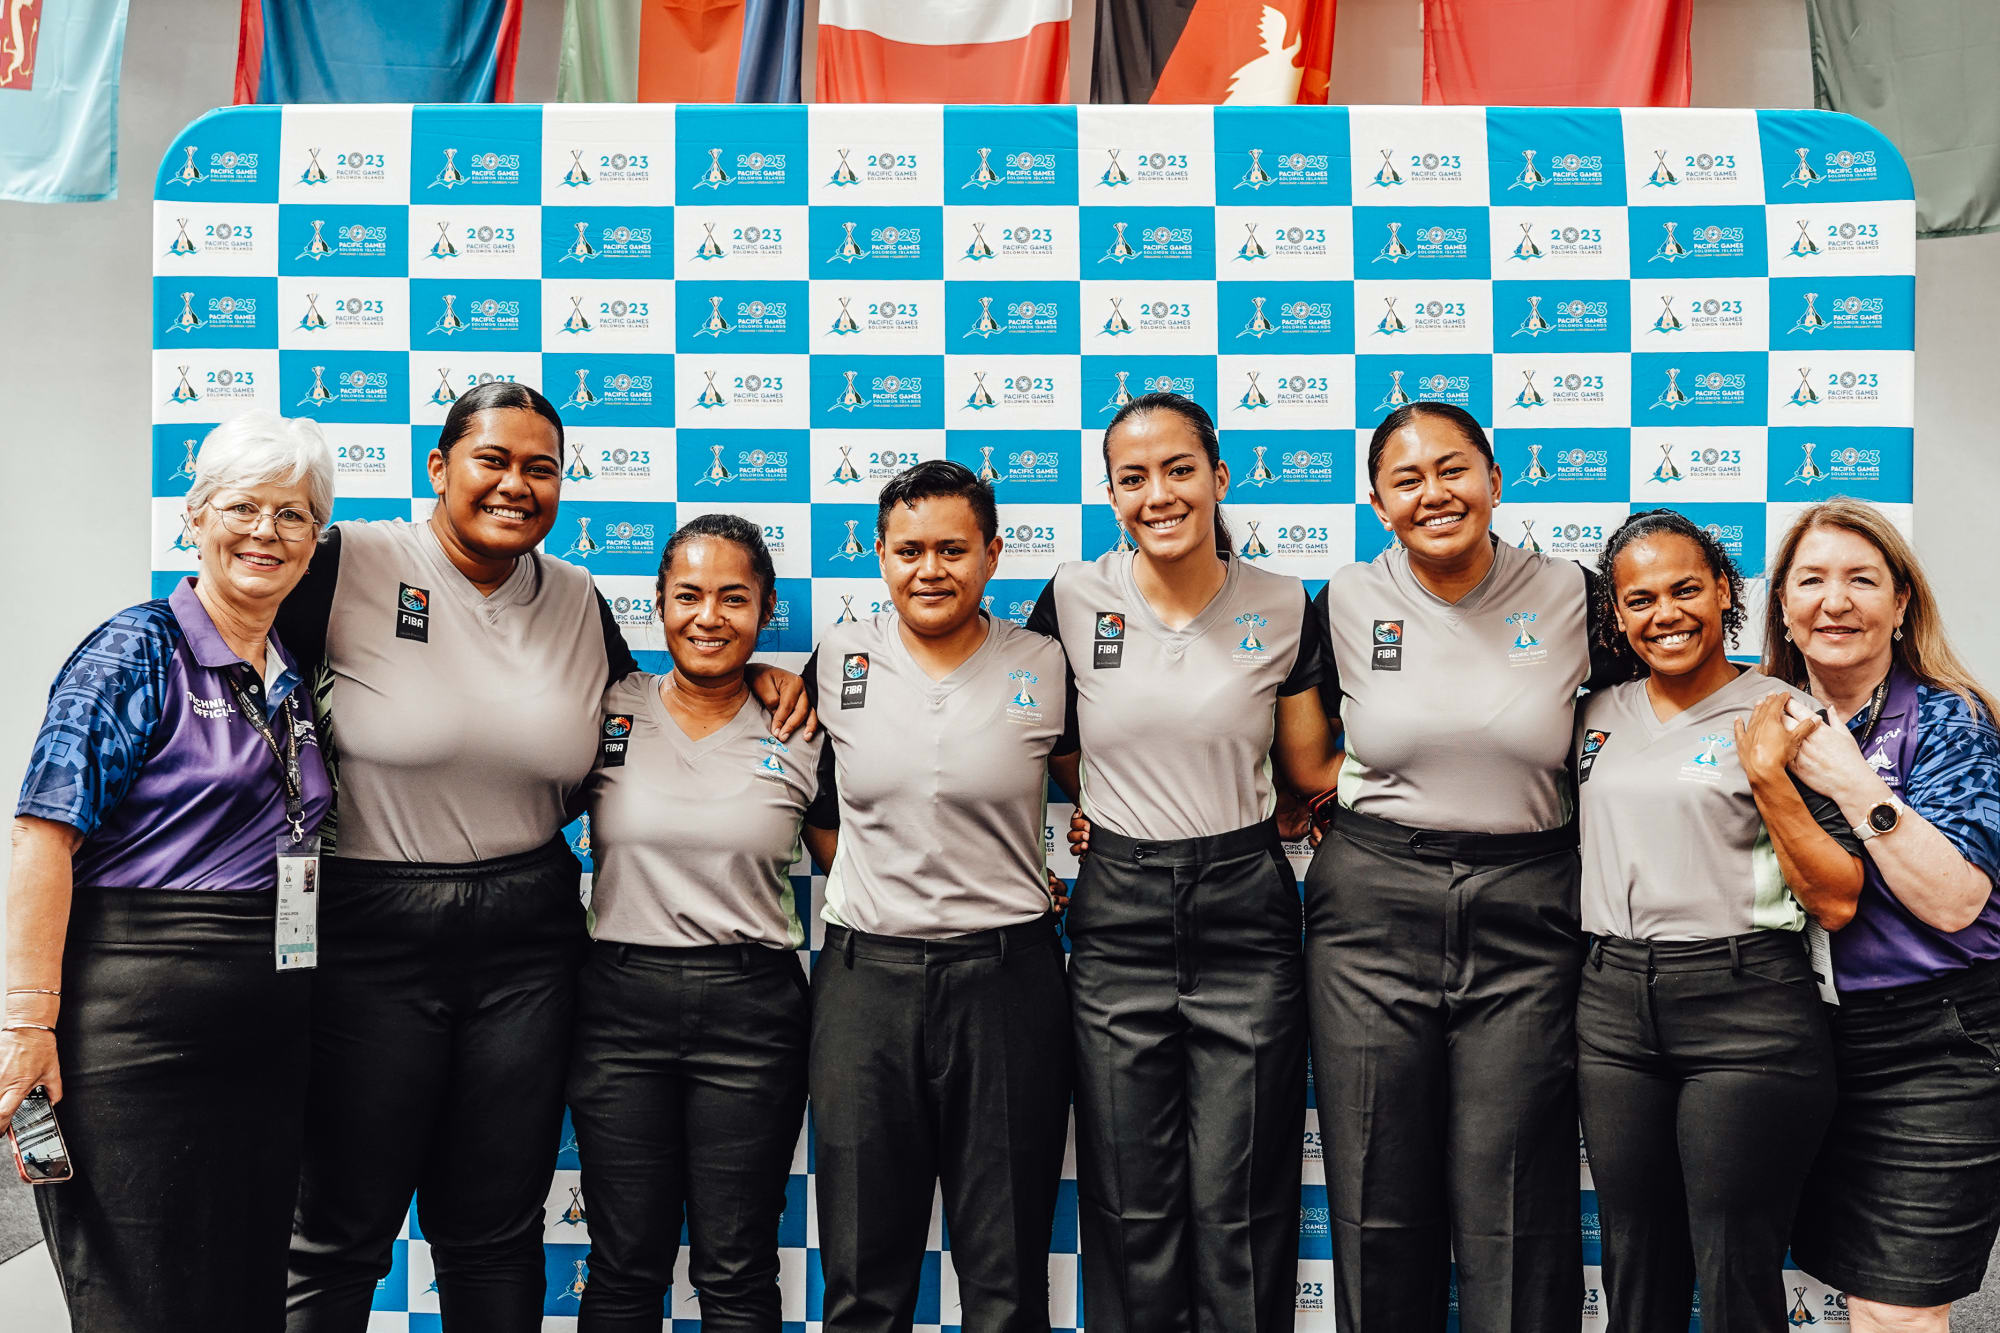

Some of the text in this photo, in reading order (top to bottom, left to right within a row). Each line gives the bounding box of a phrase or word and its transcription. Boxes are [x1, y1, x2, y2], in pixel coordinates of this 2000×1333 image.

[210, 151, 259, 169] 2023
[337, 152, 385, 169] 2023
[471, 152, 520, 170] 2023
[600, 153, 649, 170] 2023
[737, 152, 786, 170] 2023
[867, 153, 917, 170] 2023
[1006, 152, 1056, 170] 2023
[1138, 152, 1188, 170] 2023
[1278, 153, 1328, 171] 2023
[1411, 153, 1461, 170] 2023
[1552, 154, 1603, 172] 2023
[1685, 153, 1736, 170] 2023
[1825, 149, 1877, 169] 2023
[205, 222, 253, 240] 2023
[338, 224, 387, 242] 2023
[466, 226, 515, 242] 2023
[603, 226, 652, 244] 2023
[733, 226, 782, 243] 2023
[871, 226, 921, 244] 2023
[1003, 226, 1052, 244] 2023
[1143, 226, 1193, 245] 2023
[1276, 227, 1326, 244] 2023
[1417, 226, 1467, 244] 2023
[1551, 227, 1602, 243] 2023
[1693, 225, 1744, 243] 2023
[1828, 221, 1878, 240] 2023
[208, 296, 256, 314] 2023
[335, 297, 384, 315] 2023
[471, 298, 520, 317] 2023
[600, 300, 649, 317] 2023
[737, 300, 787, 319] 2023
[868, 301, 918, 318] 2023
[1008, 301, 1058, 319] 2023
[1140, 301, 1190, 318] 2023
[1281, 301, 1332, 319] 2023
[1415, 300, 1465, 318] 2023
[1557, 299, 1608, 318] 2023
[1692, 298, 1742, 316] 2023
[1833, 296, 1884, 315] 2023
[206, 369, 254, 386] 2023
[340, 370, 388, 388] 2023
[604, 373, 653, 392] 2023
[734, 374, 783, 392] 2023
[872, 375, 922, 393] 2023
[1004, 375, 1054, 393] 2023
[1144, 376, 1194, 393] 2023
[1278, 375, 1328, 392] 2023
[1419, 374, 1469, 392] 2023
[1553, 373, 1604, 391] 2023
[1695, 372, 1746, 390] 2023
[1828, 371, 1879, 388] 2023
[338, 444, 386, 462] 2023
[601, 448, 650, 465] 2023
[739, 449, 788, 468] 2023
[869, 451, 919, 467] 2023
[1009, 450, 1059, 468] 2023
[1282, 450, 1333, 468] 2023
[1557, 448, 1608, 467] 2023
[1691, 448, 1741, 465] 2023
[1830, 447, 1881, 466] 2023
[606, 521, 655, 540] 2023
[764, 526, 784, 540] 23
[1005, 525, 1055, 542] 2023
[1278, 525, 1328, 542] 2023
[1552, 524, 1602, 541] 2023
[402, 614, 424, 628] FIBA
[1098, 645, 1118, 654] FIBA
[1378, 649, 1397, 658] FIBA
[844, 685, 862, 695] FIBA
[605, 743, 624, 752] FIBA
[1824, 1292, 1848, 1309] 20
